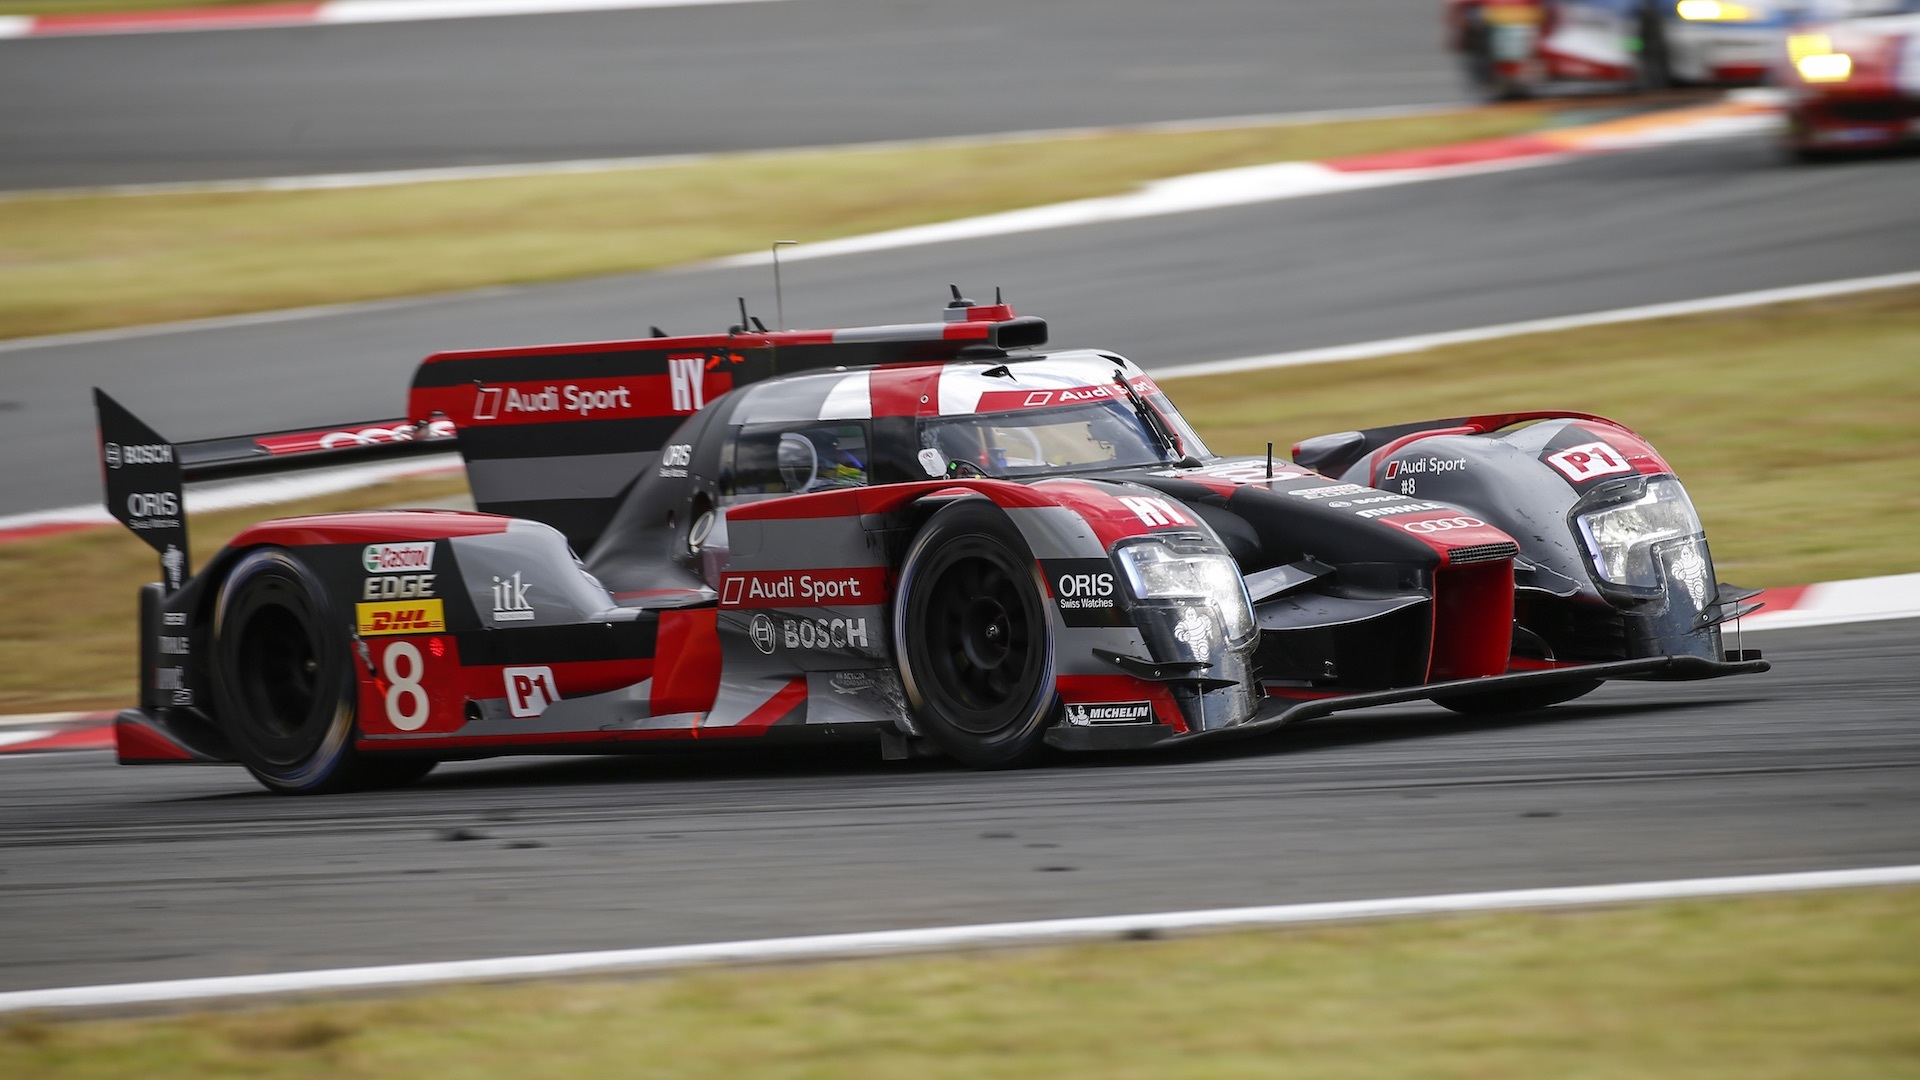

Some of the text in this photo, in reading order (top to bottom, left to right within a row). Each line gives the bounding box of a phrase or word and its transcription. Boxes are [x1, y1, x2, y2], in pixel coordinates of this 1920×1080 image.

[668, 357, 705, 410] HY
[1059, 381, 1153, 402] Audi Sort
[504, 384, 631, 415] Audi Sport
[123, 444, 173, 464] BOSCH
[1400, 457, 1466, 475] Audi Sport
[1562, 447, 1618, 473] P1
[1401, 478, 1415, 495] #8
[127, 491, 178, 517] ORIS
[1119, 497, 1187, 527] HY
[1355, 502, 1445, 518] MAHLE
[363, 574, 437, 600] EDGE
[491, 570, 534, 610] itk
[749, 575, 861, 602] Audi Sport
[1059, 573, 1113, 597] ORIS
[1060, 597, 1113, 609] Swiss Watches
[371, 609, 431, 631] DHL
[784, 617, 869, 649] BOSCH
[383, 641, 430, 731] 8
[512, 674, 554, 709] P1
[1089, 706, 1149, 719] MICHELIN
